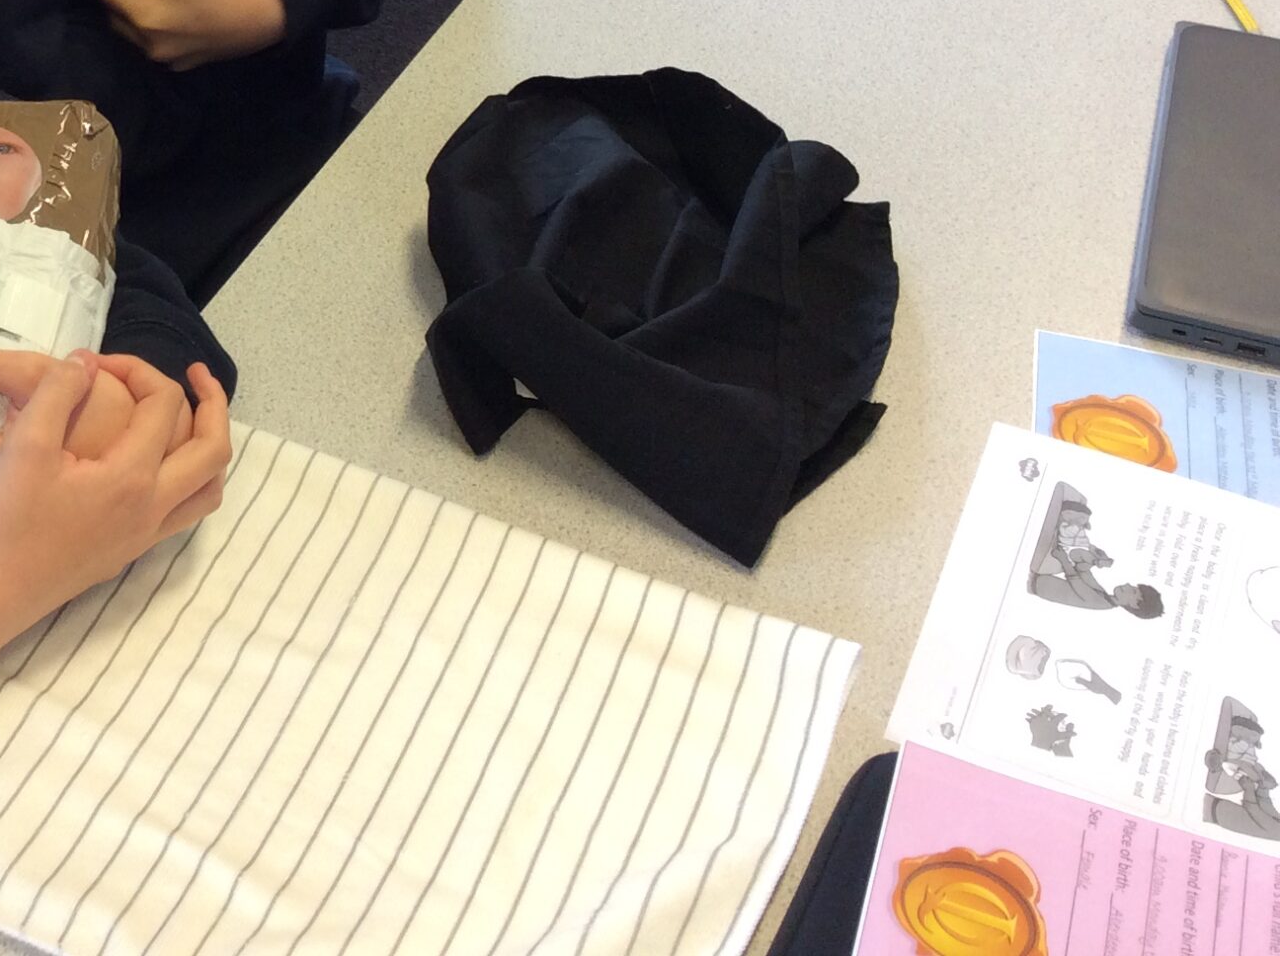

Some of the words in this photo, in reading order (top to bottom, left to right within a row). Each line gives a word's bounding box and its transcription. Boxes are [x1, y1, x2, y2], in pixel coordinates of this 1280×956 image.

[1196, 516, 1208, 536] place
[1214, 522, 1227, 541] Once
[1153, 538, 1165, 558] place
[1173, 534, 1187, 551] Fold
[1210, 545, 1221, 557] the
[1170, 552, 1179, 568] over
[1190, 544, 1203, 563] fresh
[1148, 560, 1157, 577] with
[1180, 565, 1195, 588] nappy
[1201, 561, 1216, 579] baby
[1164, 571, 1174, 587] and
[1173, 590, 1188, 632] underneath
[1196, 594, 1208, 615] clean
[1191, 618, 1201, 634] and
[1169, 634, 1179, 647] the
[1160, 664, 1172, 686] before
[1134, 693, 1146, 703] of
[1176, 689, 1187, 702] the
[1132, 703, 1143, 716] the
[1148, 691, 1164, 723] washing
[1125, 716, 1140, 736] dirty
[1145, 728, 1155, 747] your
[1163, 728, 1178, 758] buttons
[1138, 752, 1152, 776] hands
[1159, 759, 1170, 775] and
[1133, 781, 1144, 799] and
[1153, 776, 1166, 804] clothes
[1088, 808, 1102, 828] Sex:
[1121, 819, 1137, 848] Place
[1119, 848, 1132, 862] of
[1189, 840, 1205, 866] Date
[1076, 851, 1095, 890] Female
[1116, 862, 1131, 889] birth:
[1187, 867, 1199, 890] and
[1184, 890, 1198, 916] time
[1183, 917, 1195, 932] of
